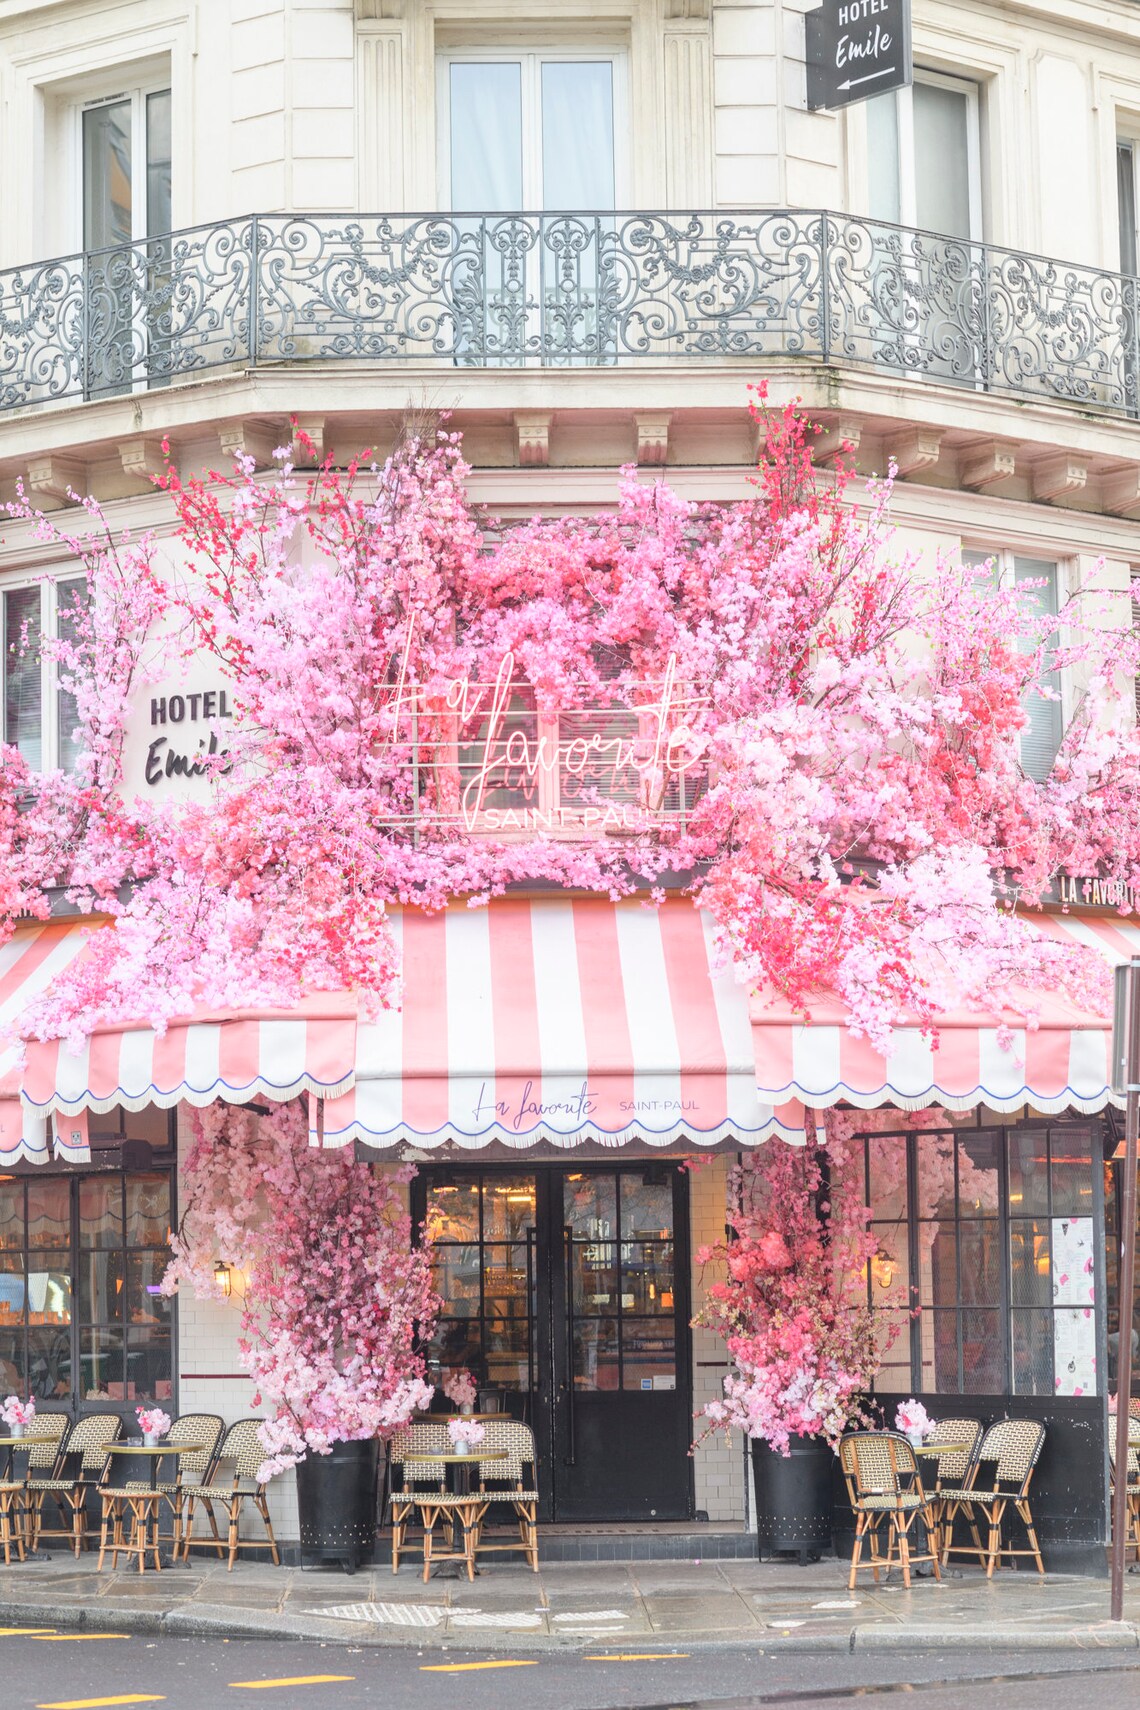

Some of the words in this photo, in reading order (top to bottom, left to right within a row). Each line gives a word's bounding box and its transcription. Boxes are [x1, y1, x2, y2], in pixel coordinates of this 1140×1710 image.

[838, 0, 889, 26] HOTEL
[835, 24, 893, 68] Emile
[150, 690, 233, 726] HOTEL
[462, 651, 712, 832] favorite
[484, 806, 662, 829] SAINT-PAUL
[1061, 876, 1078, 903] LA
[471, 1081, 510, 1122] La
[513, 1080, 599, 1130] favorite
[619, 1100, 700, 1112] SAINT-PAUL
